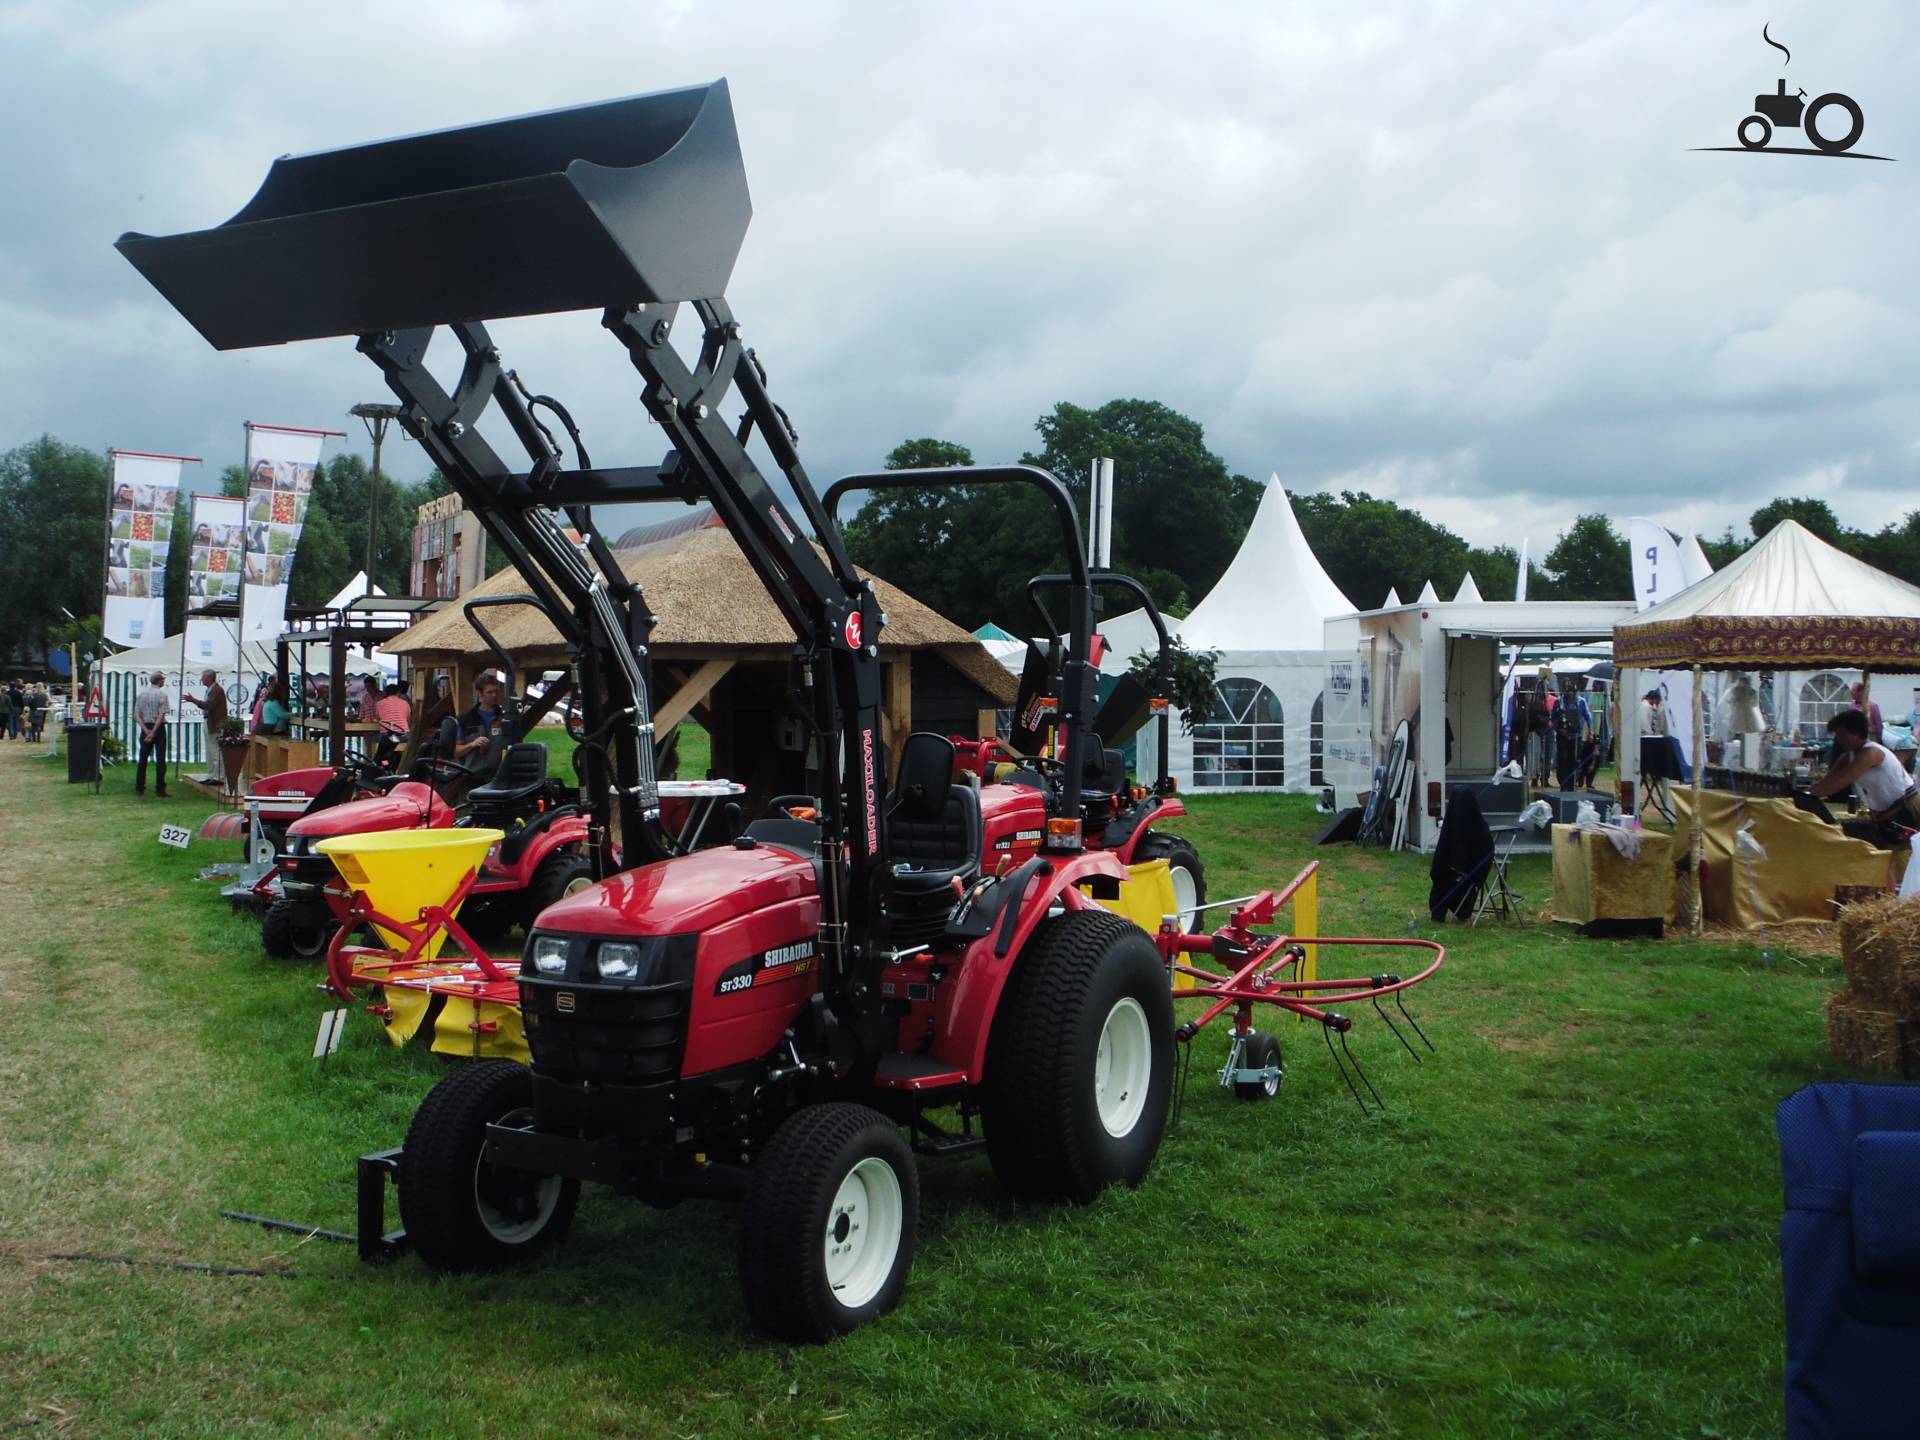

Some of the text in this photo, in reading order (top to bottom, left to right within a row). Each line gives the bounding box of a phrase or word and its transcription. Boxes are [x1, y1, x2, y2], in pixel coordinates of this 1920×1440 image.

[862, 728, 879, 857] MAXILOADER
[162, 828, 188, 843] 327
[764, 941, 814, 968] SHIBAURA
[720, 974, 752, 993] ST330
